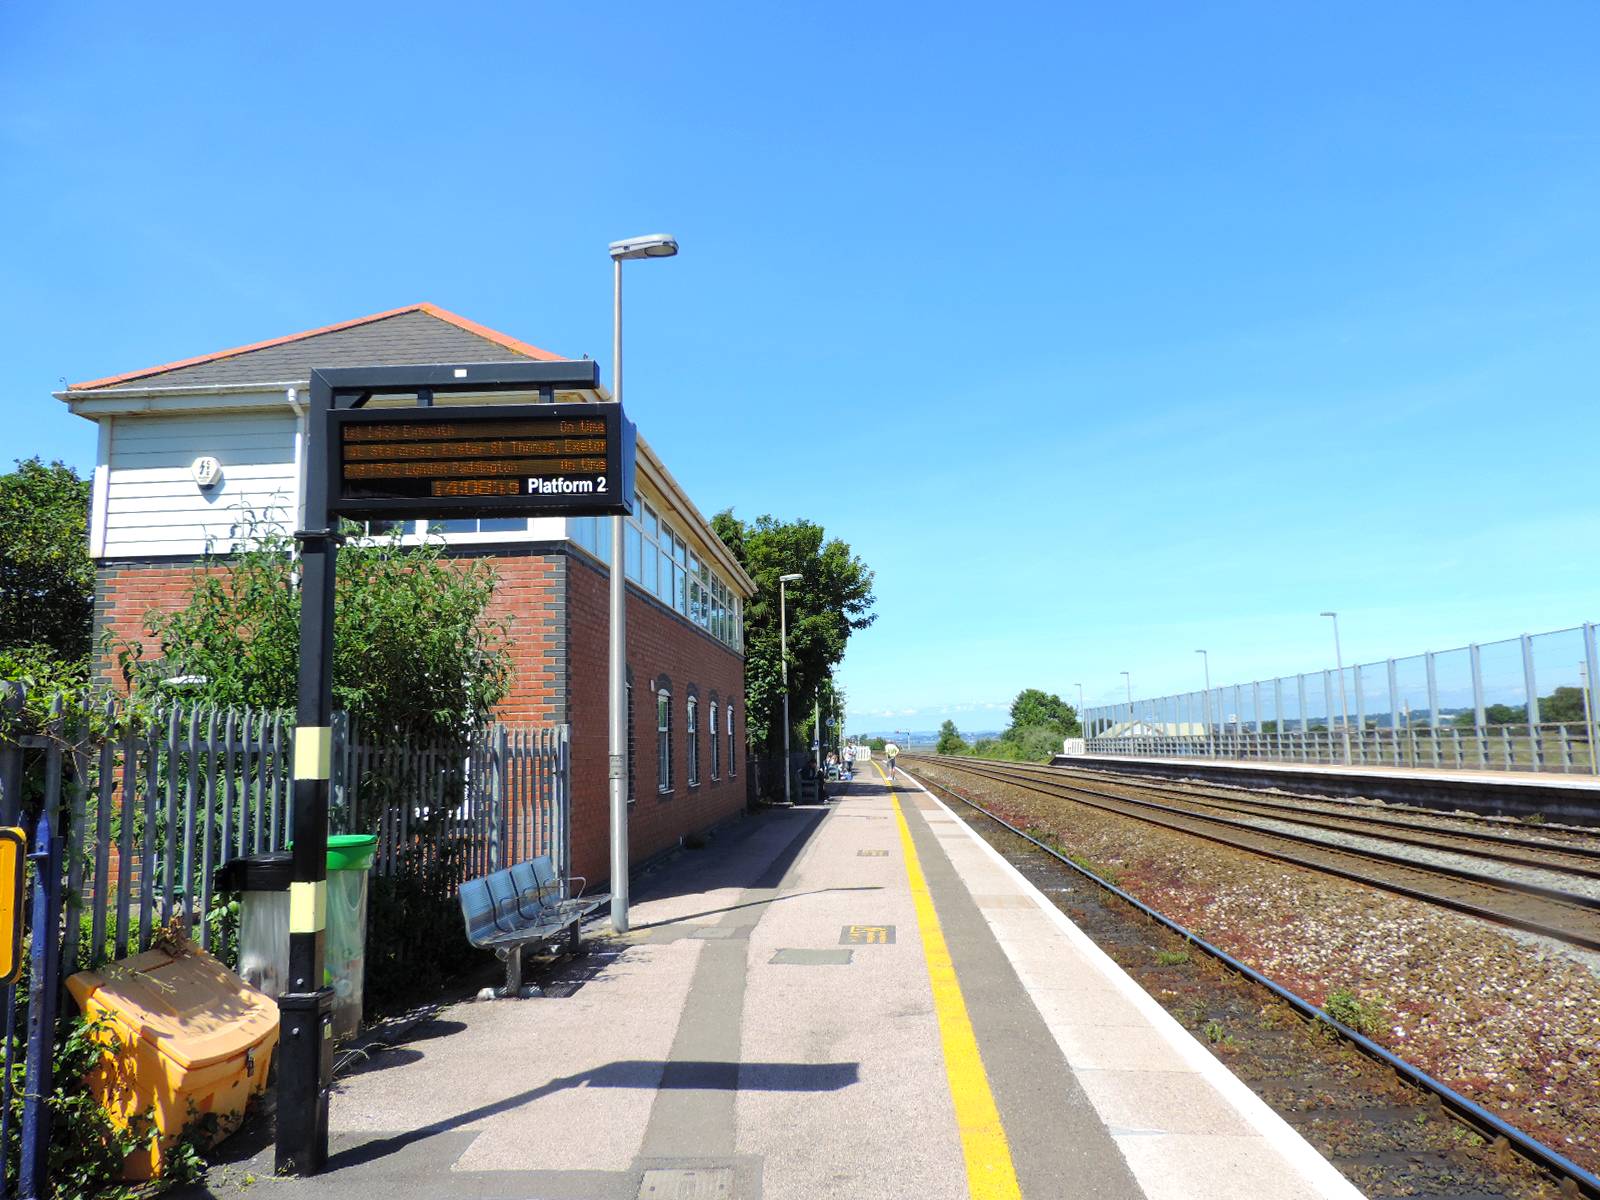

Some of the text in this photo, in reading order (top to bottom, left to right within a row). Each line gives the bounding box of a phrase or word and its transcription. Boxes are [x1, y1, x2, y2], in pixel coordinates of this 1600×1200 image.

[560, 420, 606, 433] On time
[490, 441, 505, 455] St
[452, 461, 520, 474] Paddington
[527, 476, 607, 494] Platform 2
